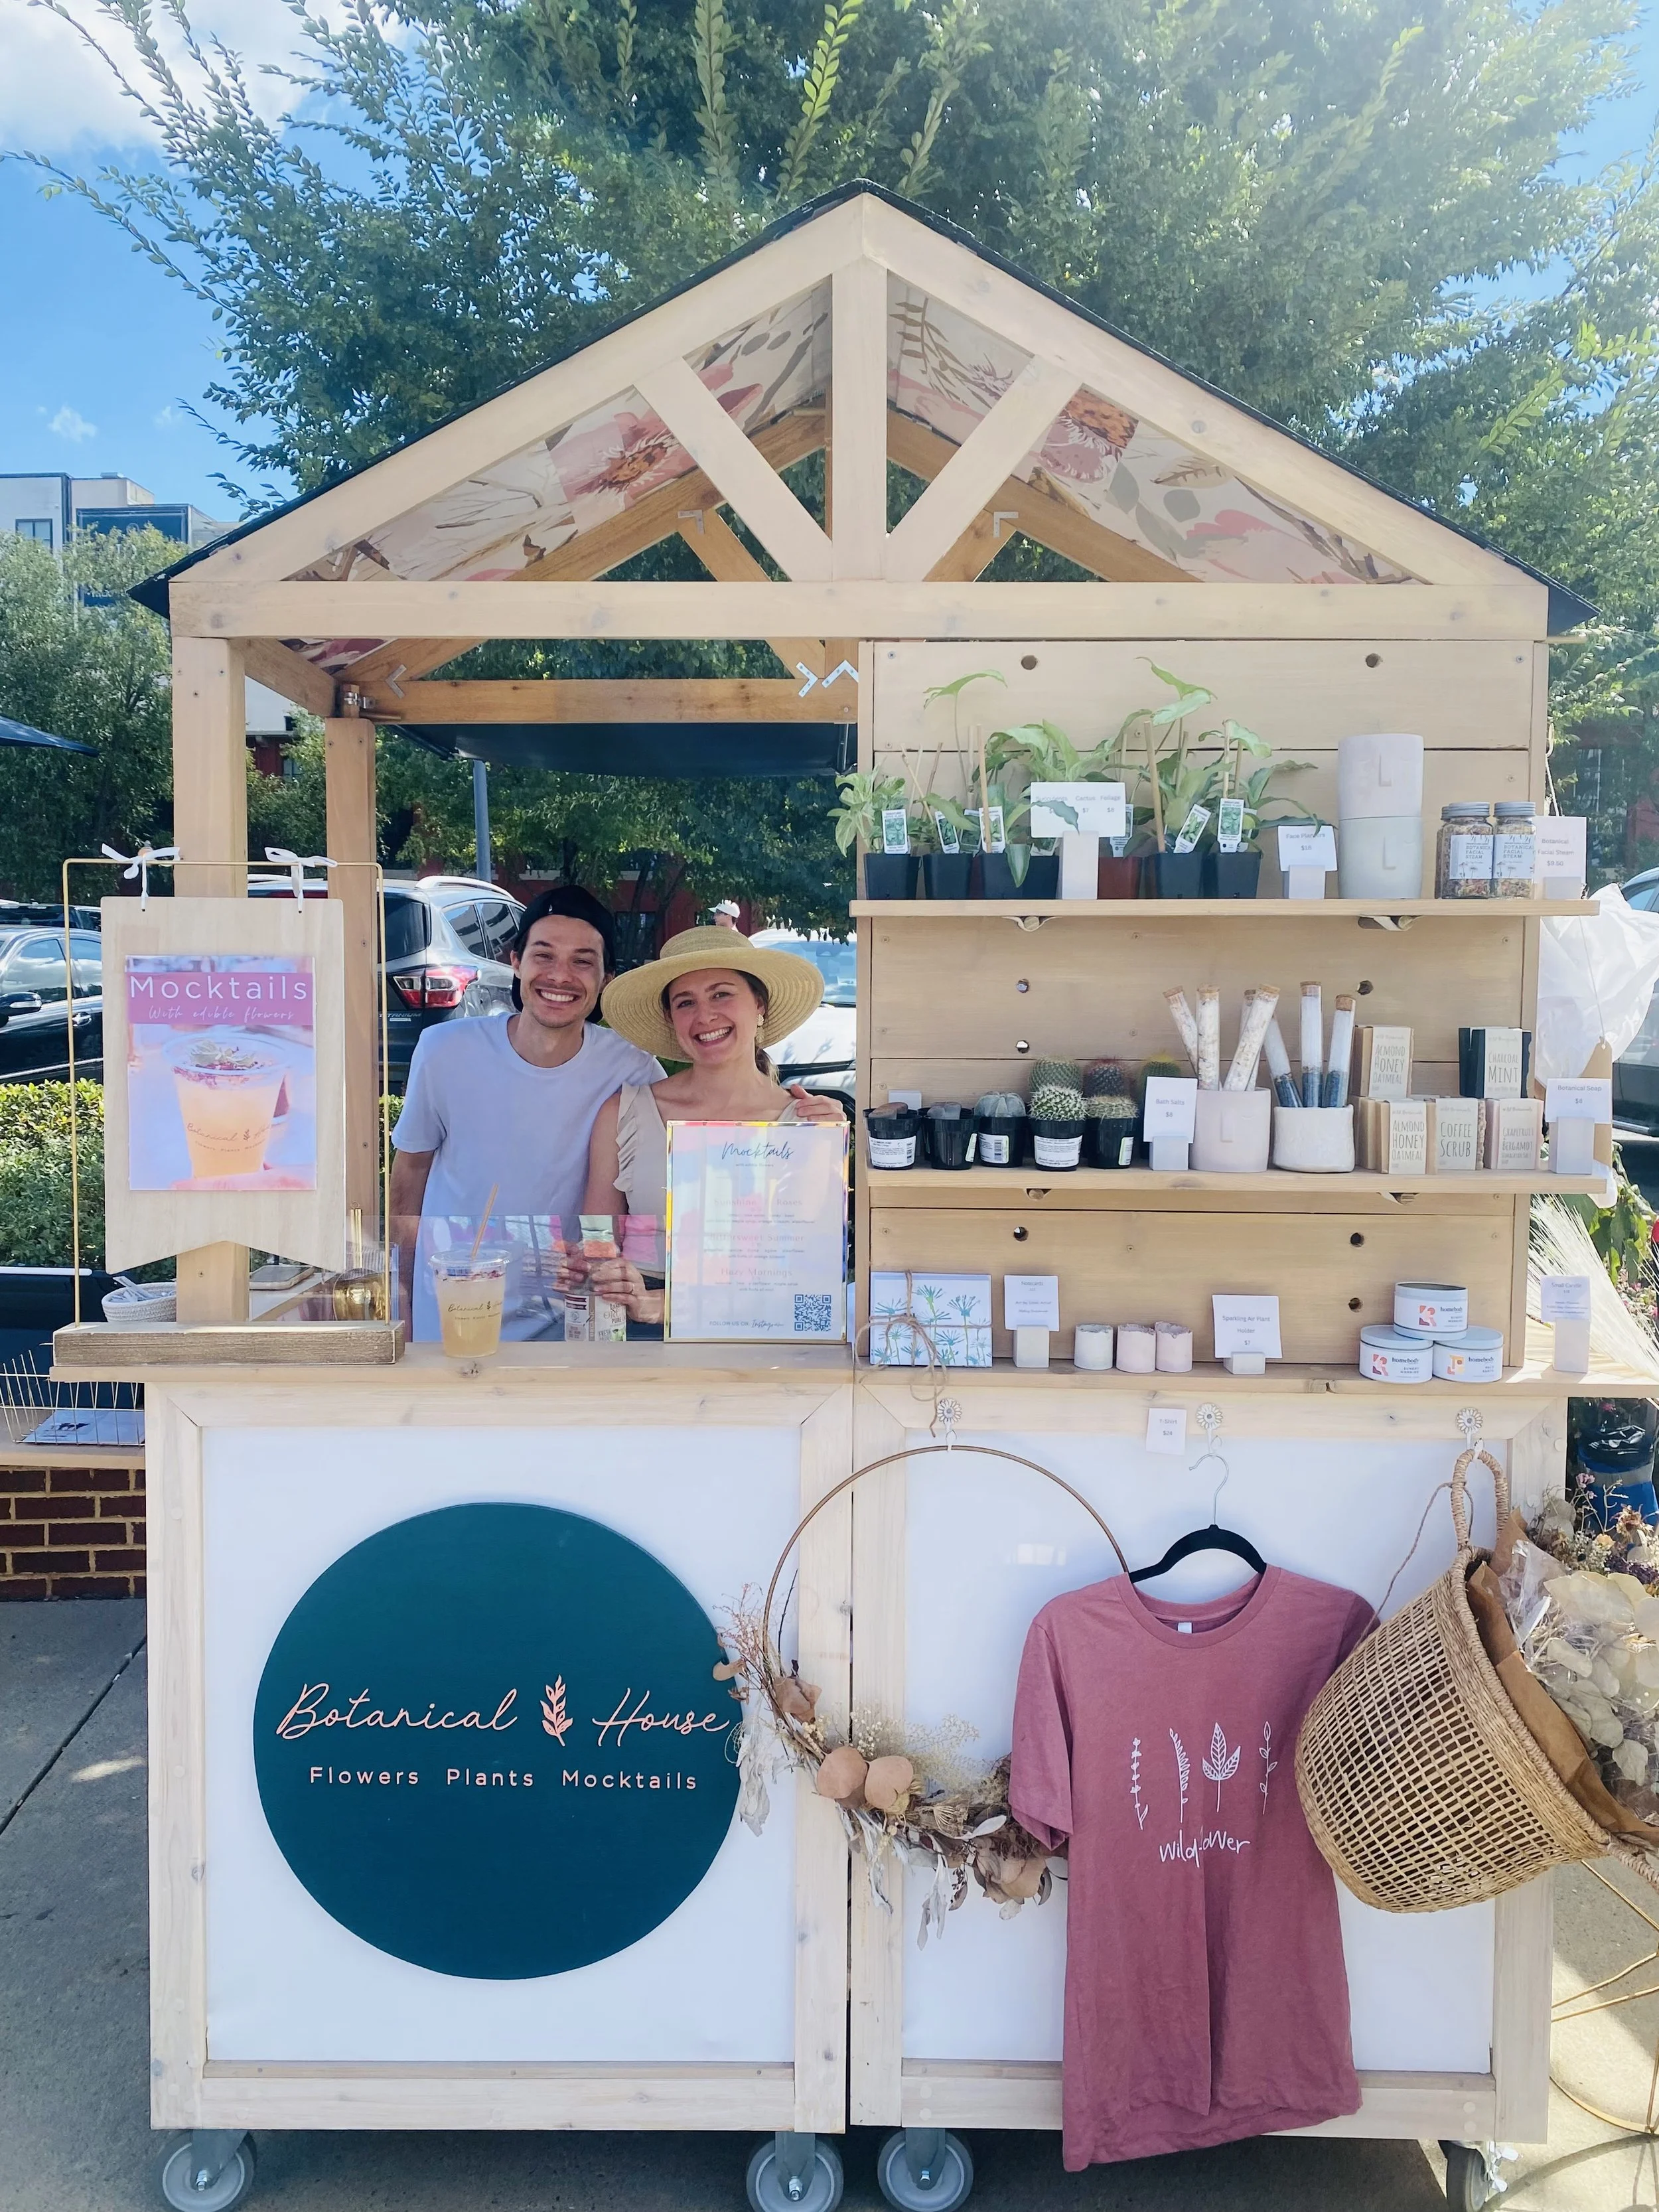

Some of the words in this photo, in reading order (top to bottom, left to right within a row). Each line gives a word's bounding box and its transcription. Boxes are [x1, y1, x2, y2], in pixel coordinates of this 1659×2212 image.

[129, 976, 307, 999] Mocktails
[149, 1005, 183, 1019] With
[192, 1006, 235, 1021] edible
[244, 1006, 294, 1023] flowers
[1375, 1044, 1405, 1057] ALMOND
[1488, 1051, 1518, 1064] CHARCOAL
[1374, 1056, 1405, 1073] HONEY
[1373, 1072, 1402, 1084] OATMEAL
[1488, 1065, 1518, 1083] MINT
[1393, 1120, 1425, 1132] ALMOND
[1441, 1122, 1472, 1138] COFFEE
[1392, 1132, 1425, 1149] HONEY
[1440, 1138, 1471, 1157] SCRUB
[1502, 1141, 1533, 1151] BERGAMOT
[721, 1141, 795, 1160] Mocktails
[1392, 1149, 1422, 1161] OATMEAL
[776, 1198, 803, 1207] Roses
[720, 1268, 744, 1277] Hazy
[749, 1268, 793, 1278] Mornings
[751, 1319, 785, 1331] Instagram
[276, 1682, 519, 1741] Botanical
[592, 1686, 730, 1747] House
[309, 1765, 420, 1785] Flowers
[445, 1767, 535, 1787] Plants
[561, 1769, 697, 1791] Mocktails
